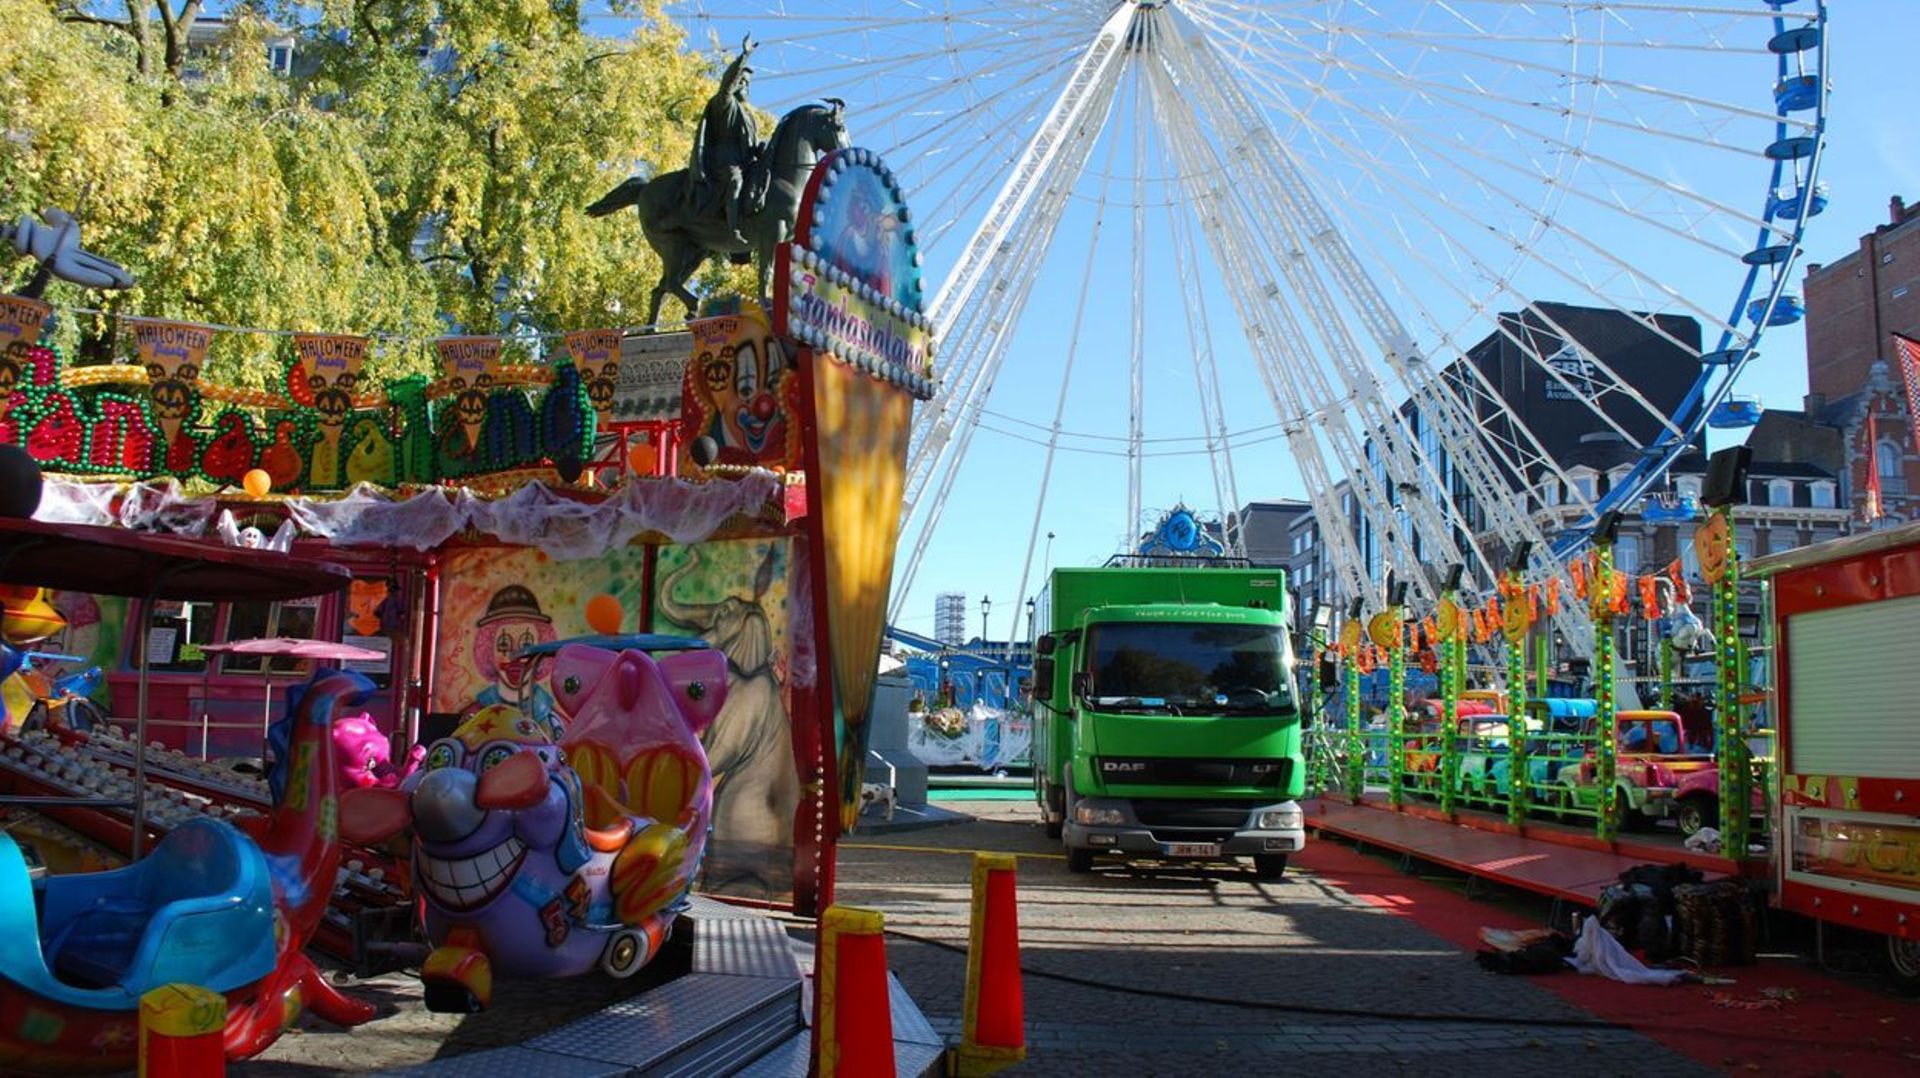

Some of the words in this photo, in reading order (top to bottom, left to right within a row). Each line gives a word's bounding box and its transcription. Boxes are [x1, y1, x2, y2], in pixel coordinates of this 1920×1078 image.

[137, 324, 207, 351] HALLOWEEN
[691, 319, 738, 337] HALLOWEEN
[299, 338, 362, 360] HALLOWEEN
[440, 342, 498, 362] HALLOWEEN
[570, 333, 620, 356] HALLOWEEN
[1103, 761, 1146, 773] DAF
[1251, 763, 1281, 774] LF
